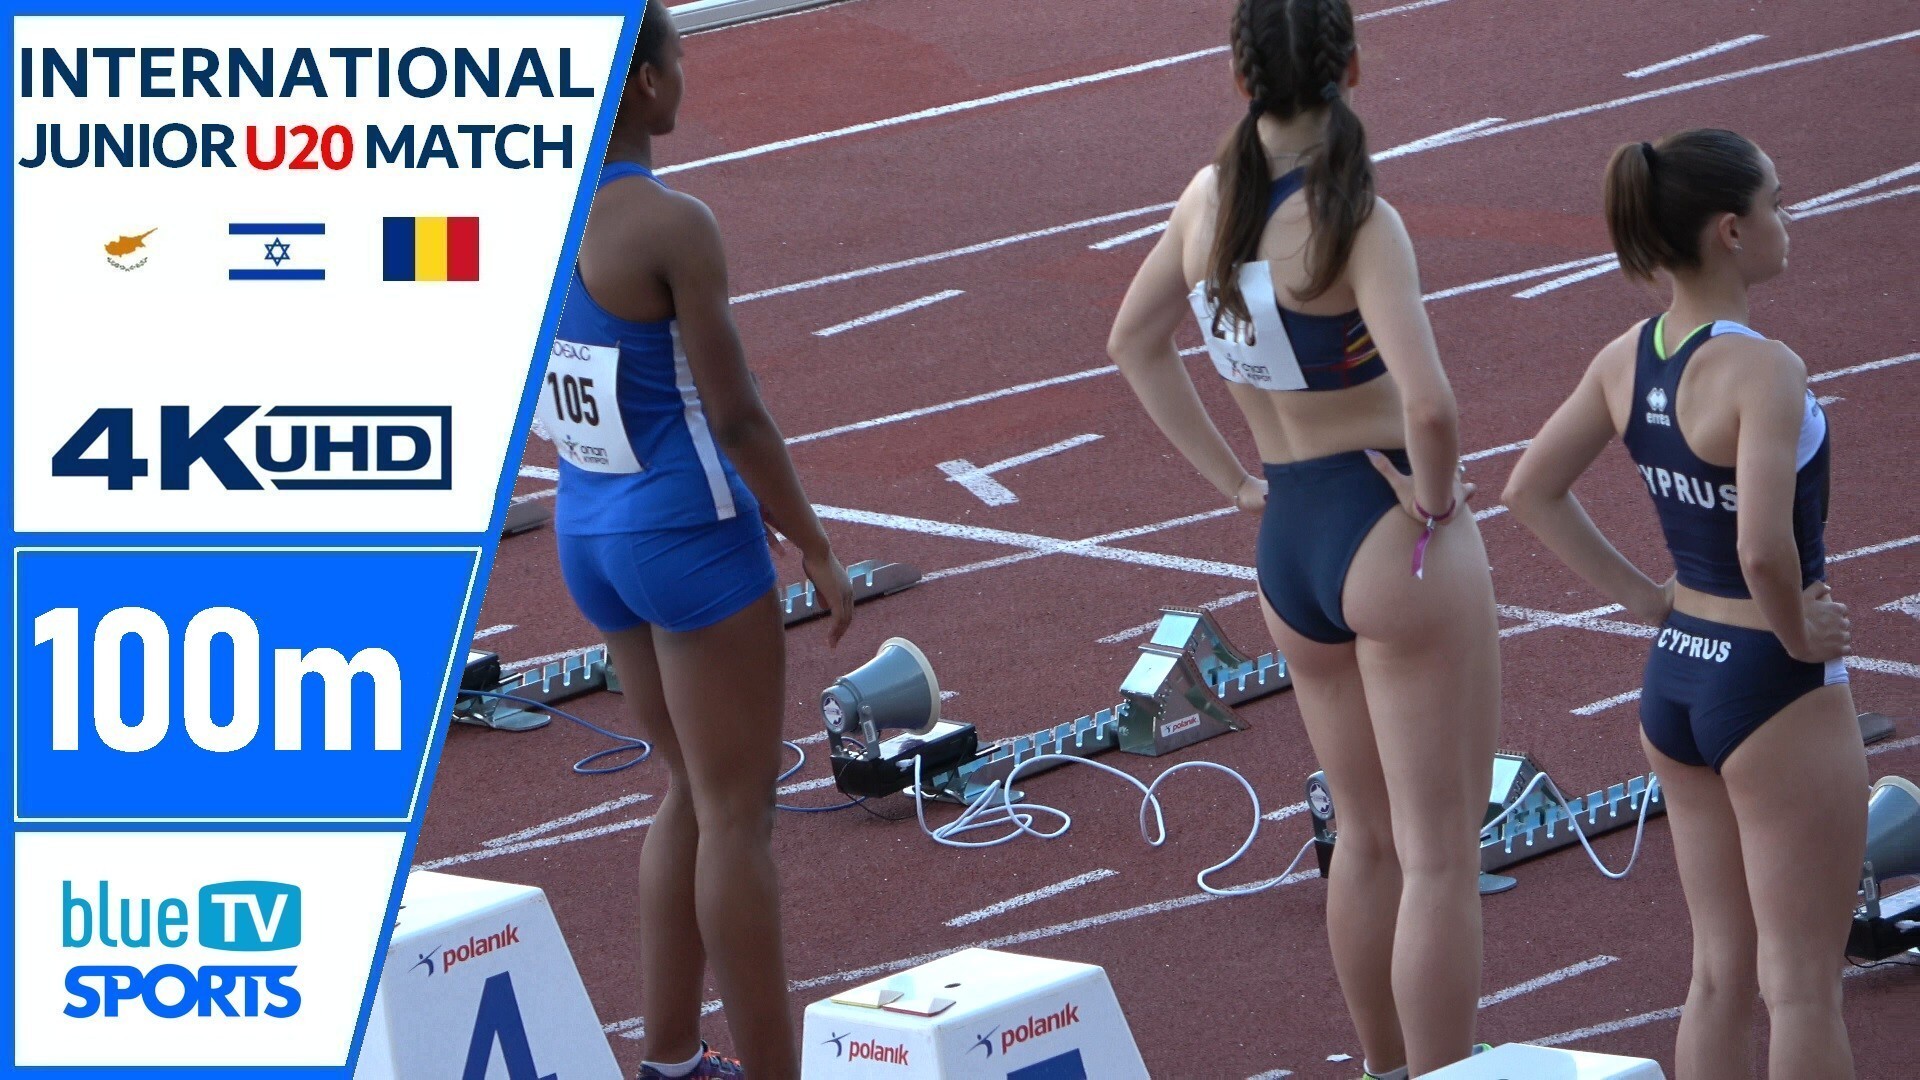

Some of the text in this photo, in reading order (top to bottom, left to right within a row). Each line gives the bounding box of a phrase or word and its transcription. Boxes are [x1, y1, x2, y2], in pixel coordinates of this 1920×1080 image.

[547, 371, 599, 426] 105
[1637, 464, 1738, 512] YPRUS
[1657, 627, 1732, 663] CYPRUS
[442, 923, 520, 974] polanik
[848, 1039, 909, 1066] polanik
[1001, 1002, 1079, 1055] polanik
